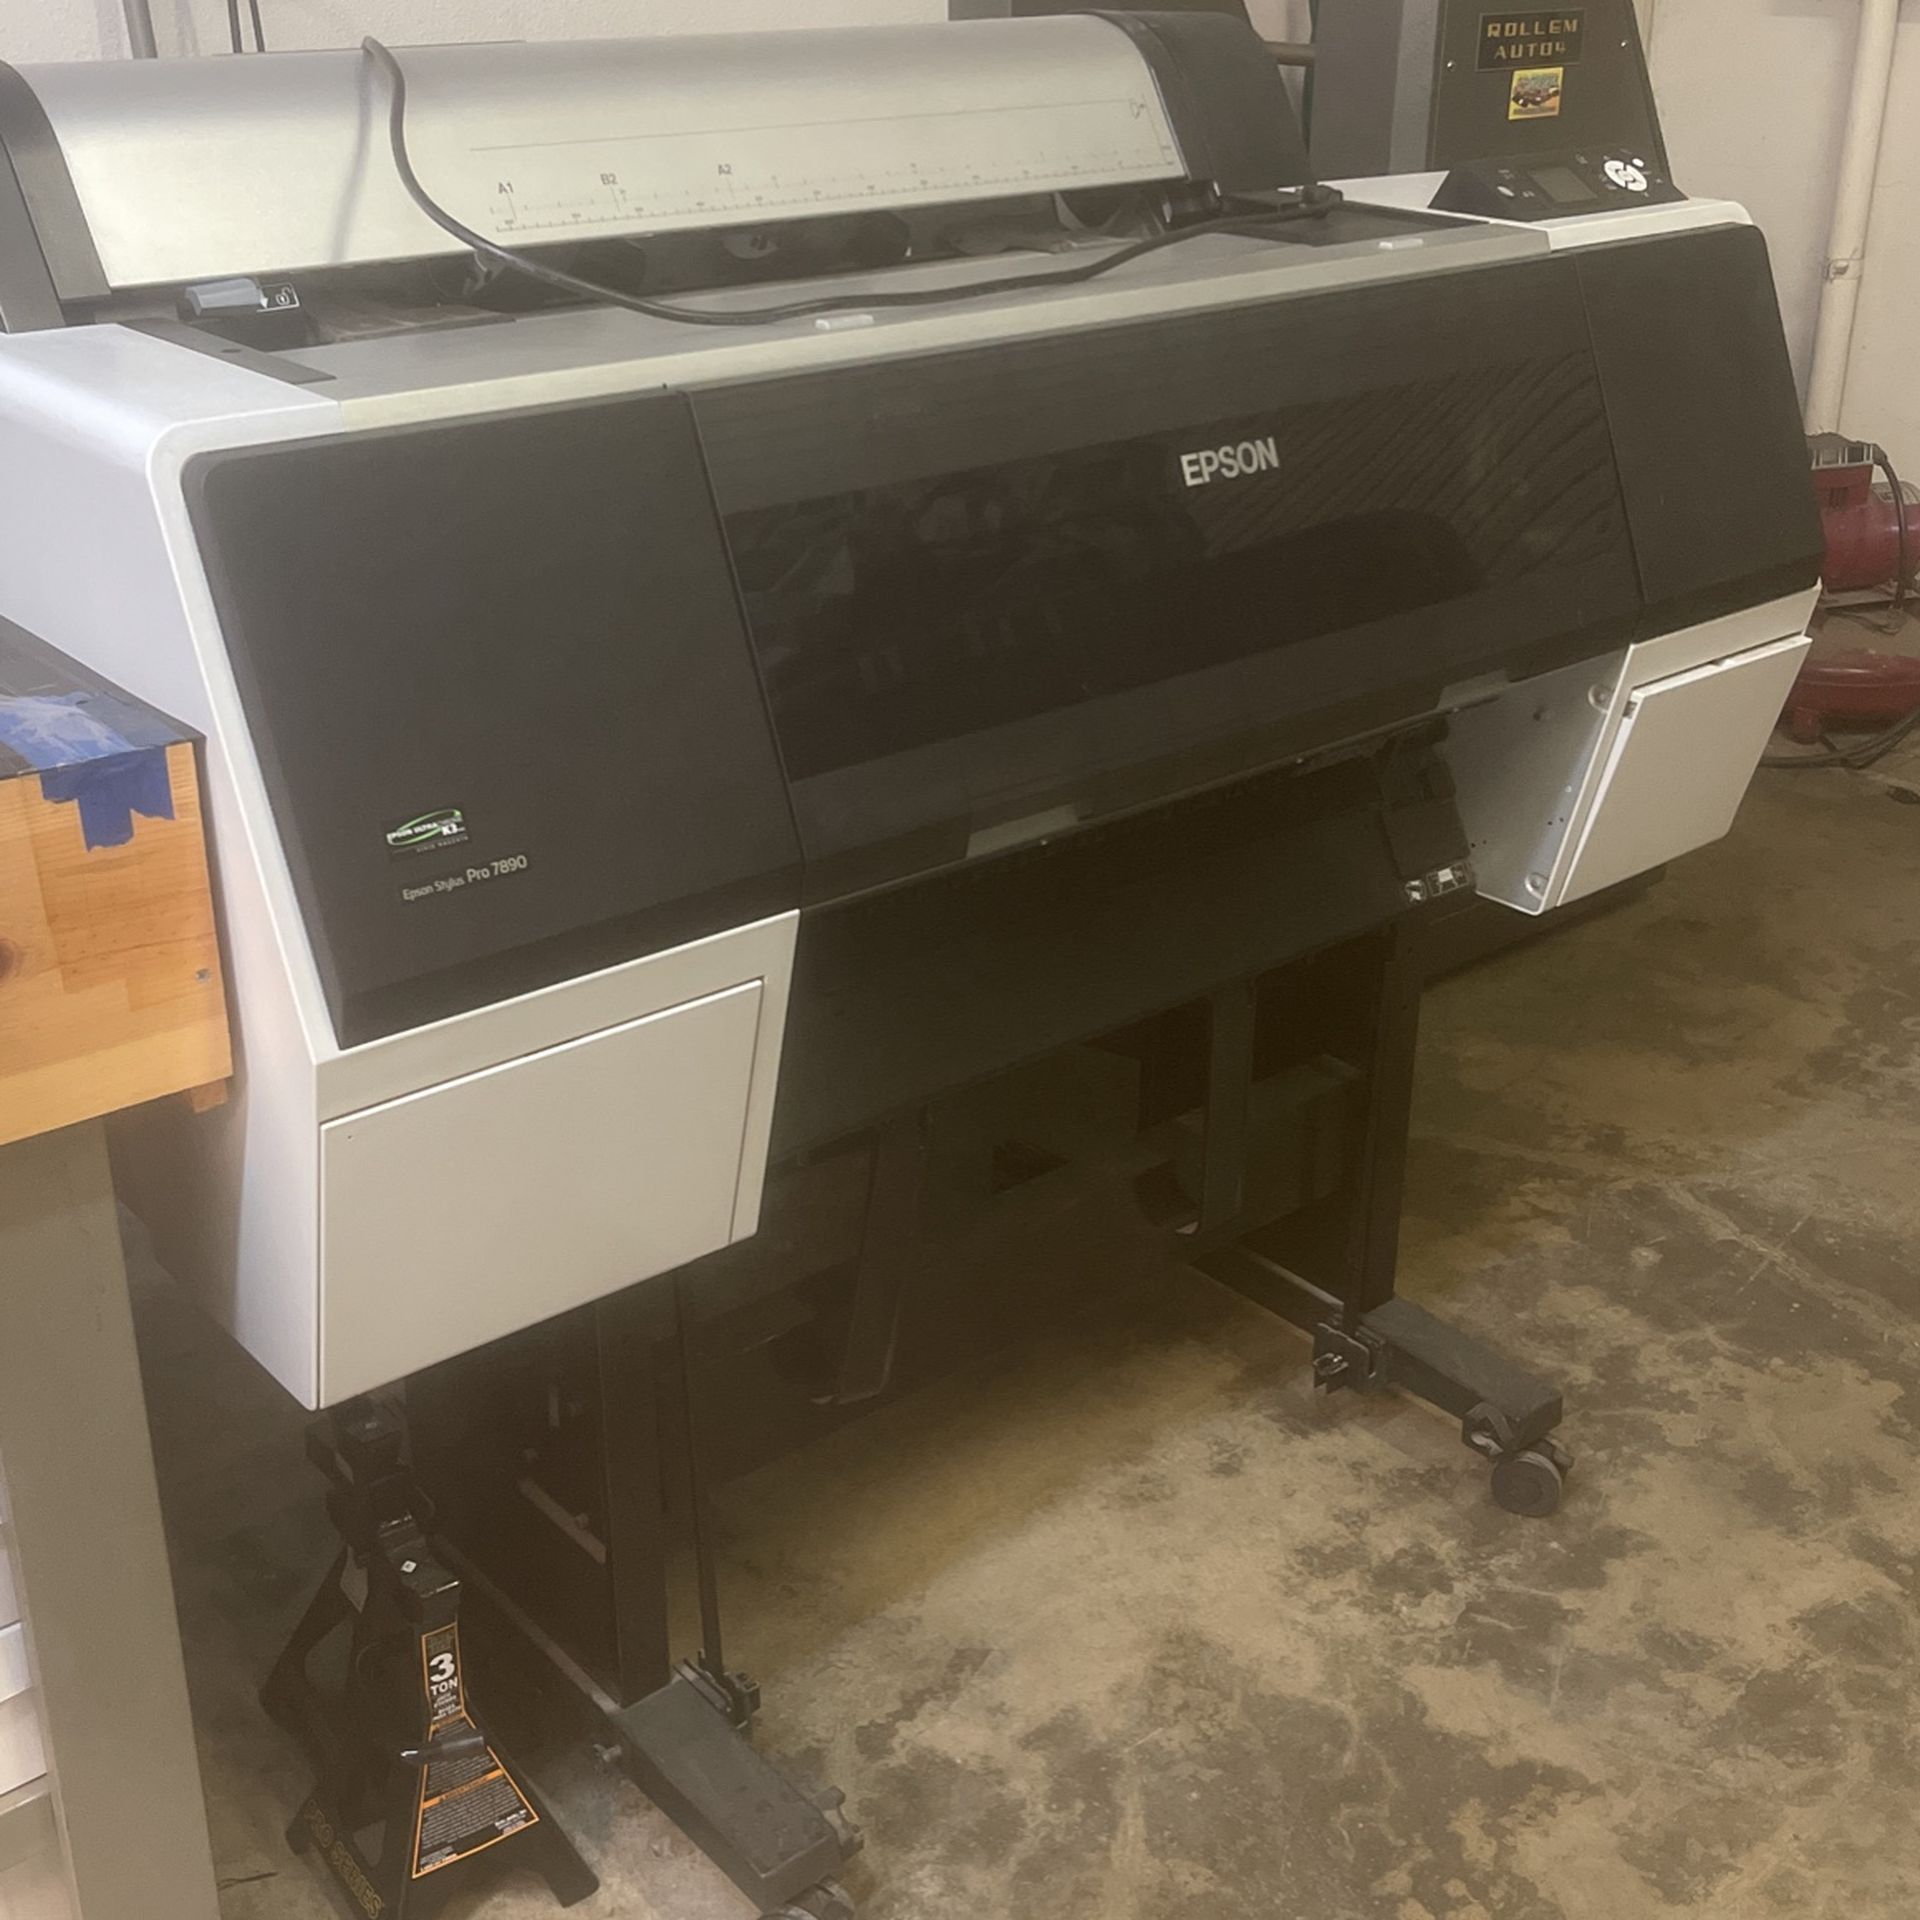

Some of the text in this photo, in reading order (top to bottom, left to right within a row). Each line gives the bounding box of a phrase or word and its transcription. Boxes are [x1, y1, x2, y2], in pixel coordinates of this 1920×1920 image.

[1487, 18, 1578, 38] ROLLEM
[601, 173, 618, 186] B2
[718, 163, 732, 176] A2
[498, 182, 514, 194] A1
[1180, 436, 1279, 487] EPSON
[402, 854, 528, 901] Epson Stylus Pro 7890
[429, 1652, 456, 1683] 3
[430, 1676, 458, 1696] TON
